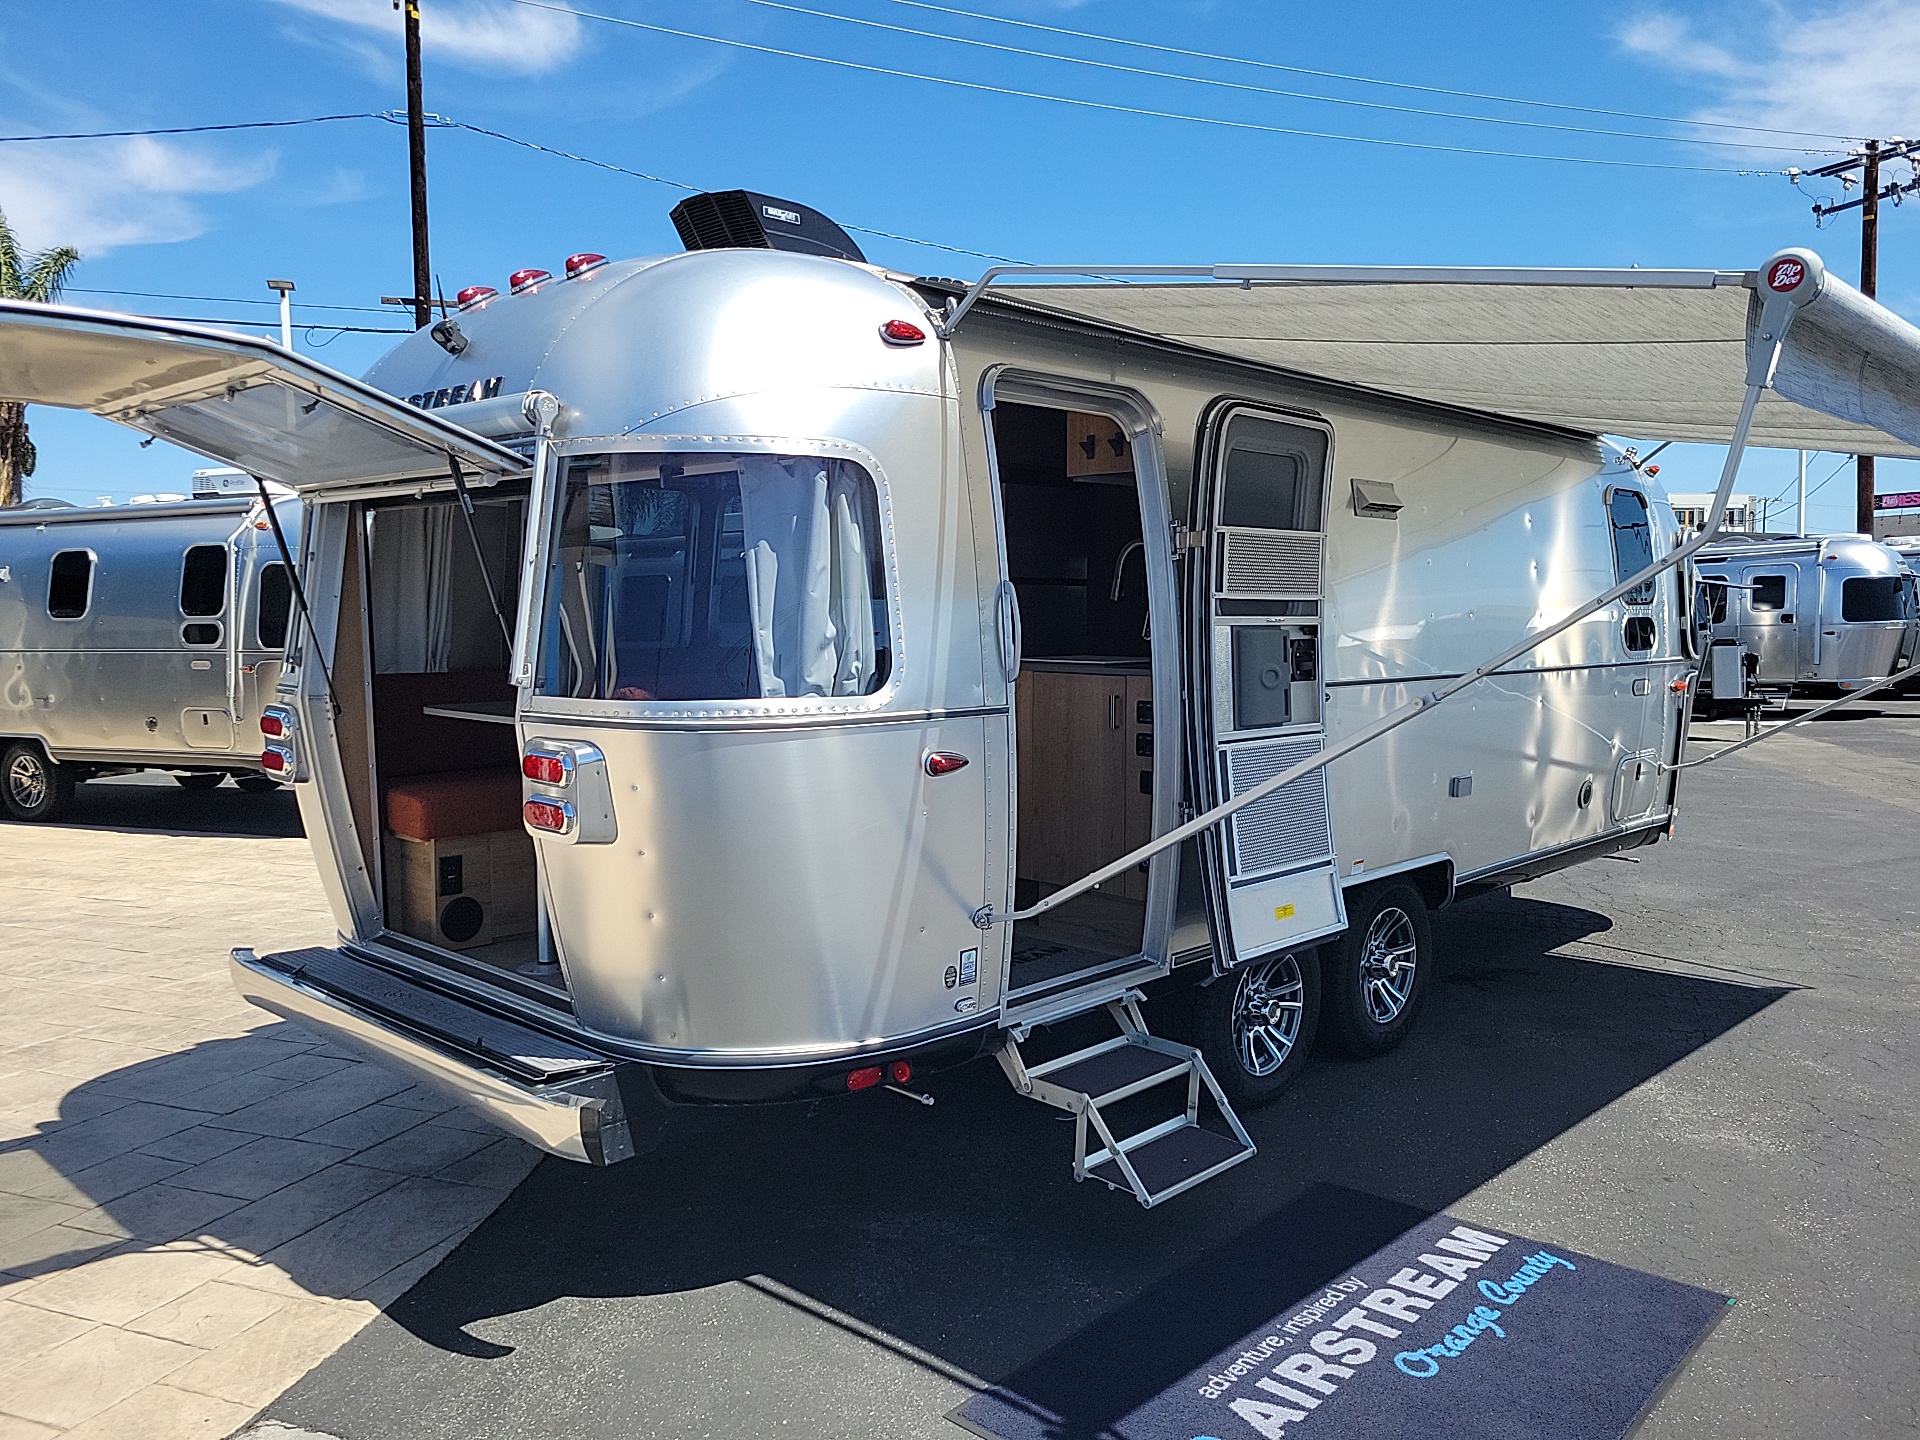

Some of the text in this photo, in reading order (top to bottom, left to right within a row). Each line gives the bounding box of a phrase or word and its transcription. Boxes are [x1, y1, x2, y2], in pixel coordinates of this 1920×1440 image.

[1772, 274, 1801, 287] Dee
[1776, 263, 1802, 277] Zip
[400, 375, 505, 410] STREAM
[1197, 1275, 1369, 1399] adventure, inspired by
[1227, 1225, 1510, 1440] AIRSTREAM
[1393, 1250, 1577, 1378] Orange County
